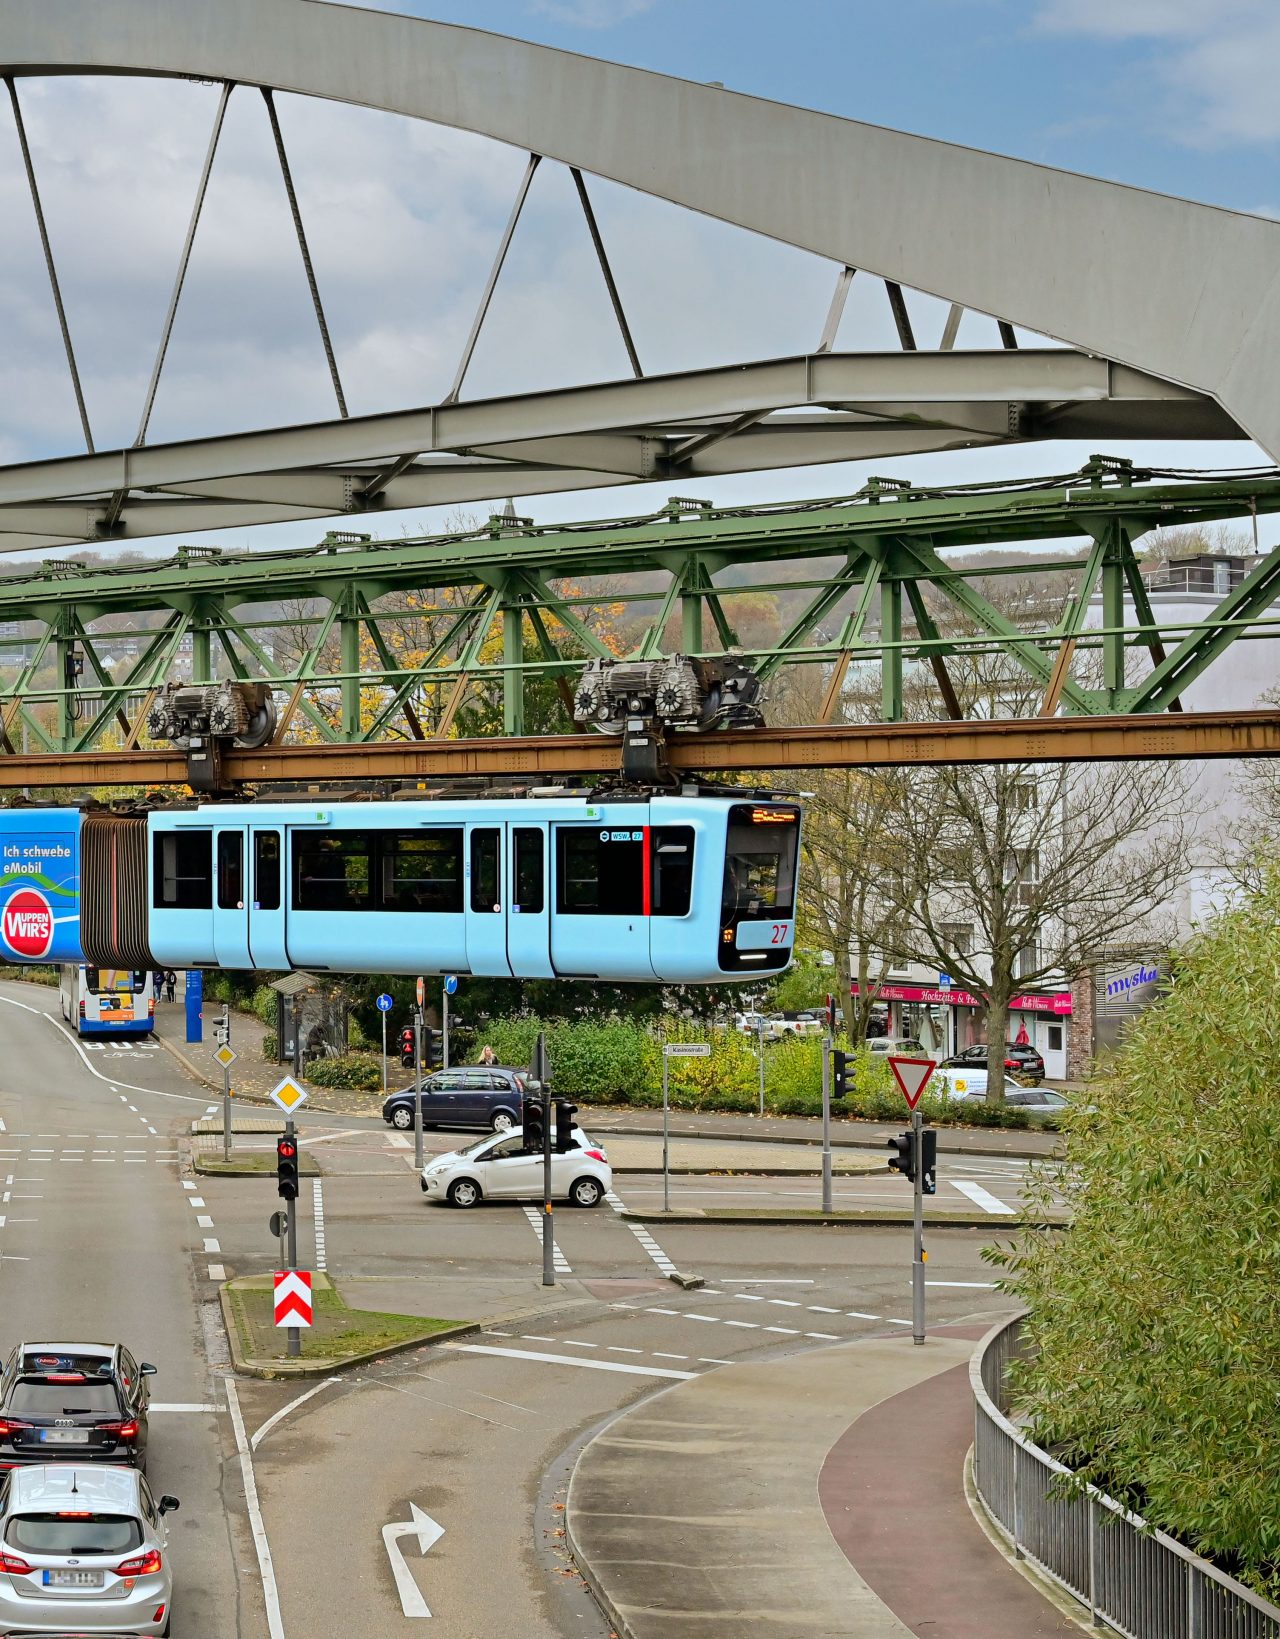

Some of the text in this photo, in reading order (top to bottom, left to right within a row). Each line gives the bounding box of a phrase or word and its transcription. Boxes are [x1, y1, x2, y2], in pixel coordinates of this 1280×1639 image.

[4, 845, 71, 857] Ich schwebe
[3, 861, 42, 873] eMobil
[7, 912, 48, 927] WUPPEN
[771, 924, 788, 944] 27
[957, 993, 964, 1003] &
[82, 1041, 160, 1050] BUS
